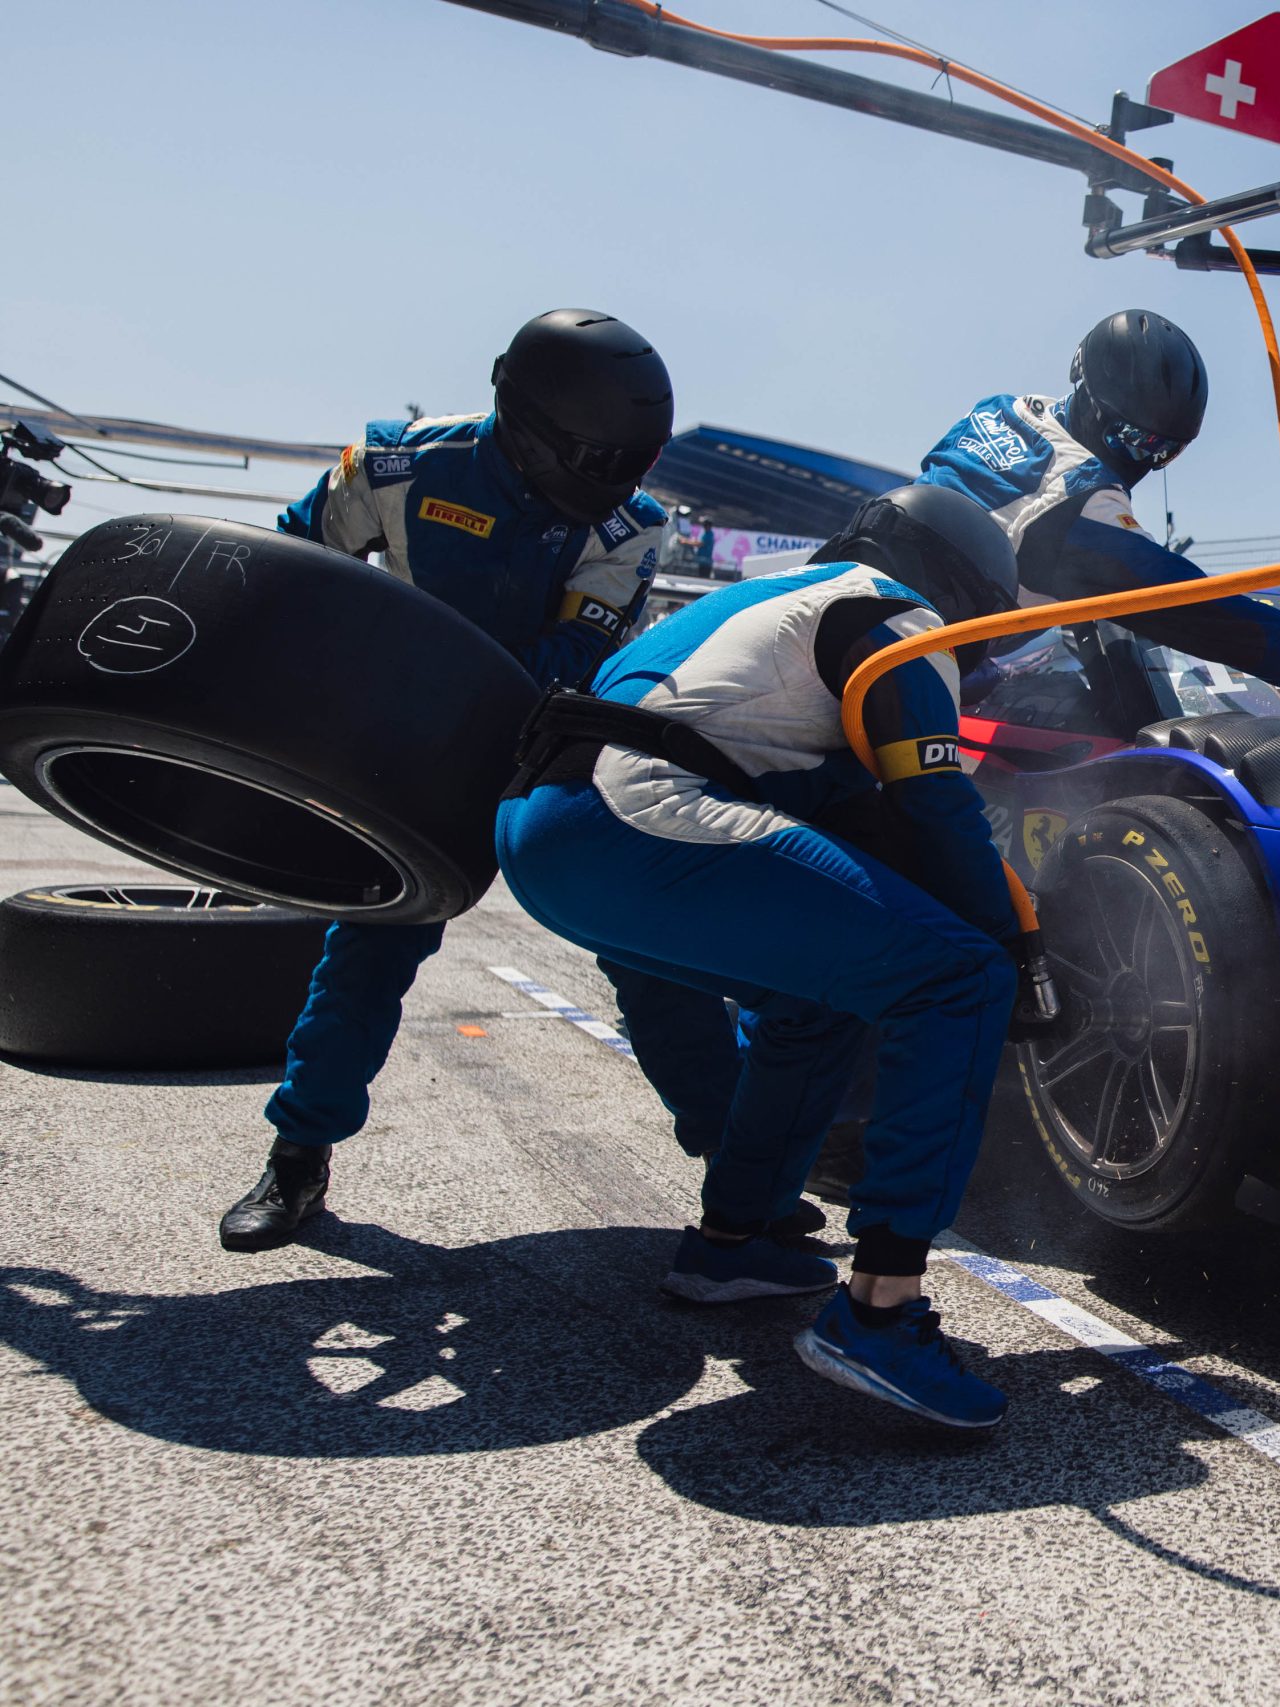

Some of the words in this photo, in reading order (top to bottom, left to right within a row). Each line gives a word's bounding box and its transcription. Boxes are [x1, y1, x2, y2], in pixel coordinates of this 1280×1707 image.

[373, 459, 411, 474] OMP
[425, 502, 489, 533] PIRELLI
[605, 517, 628, 539] MP
